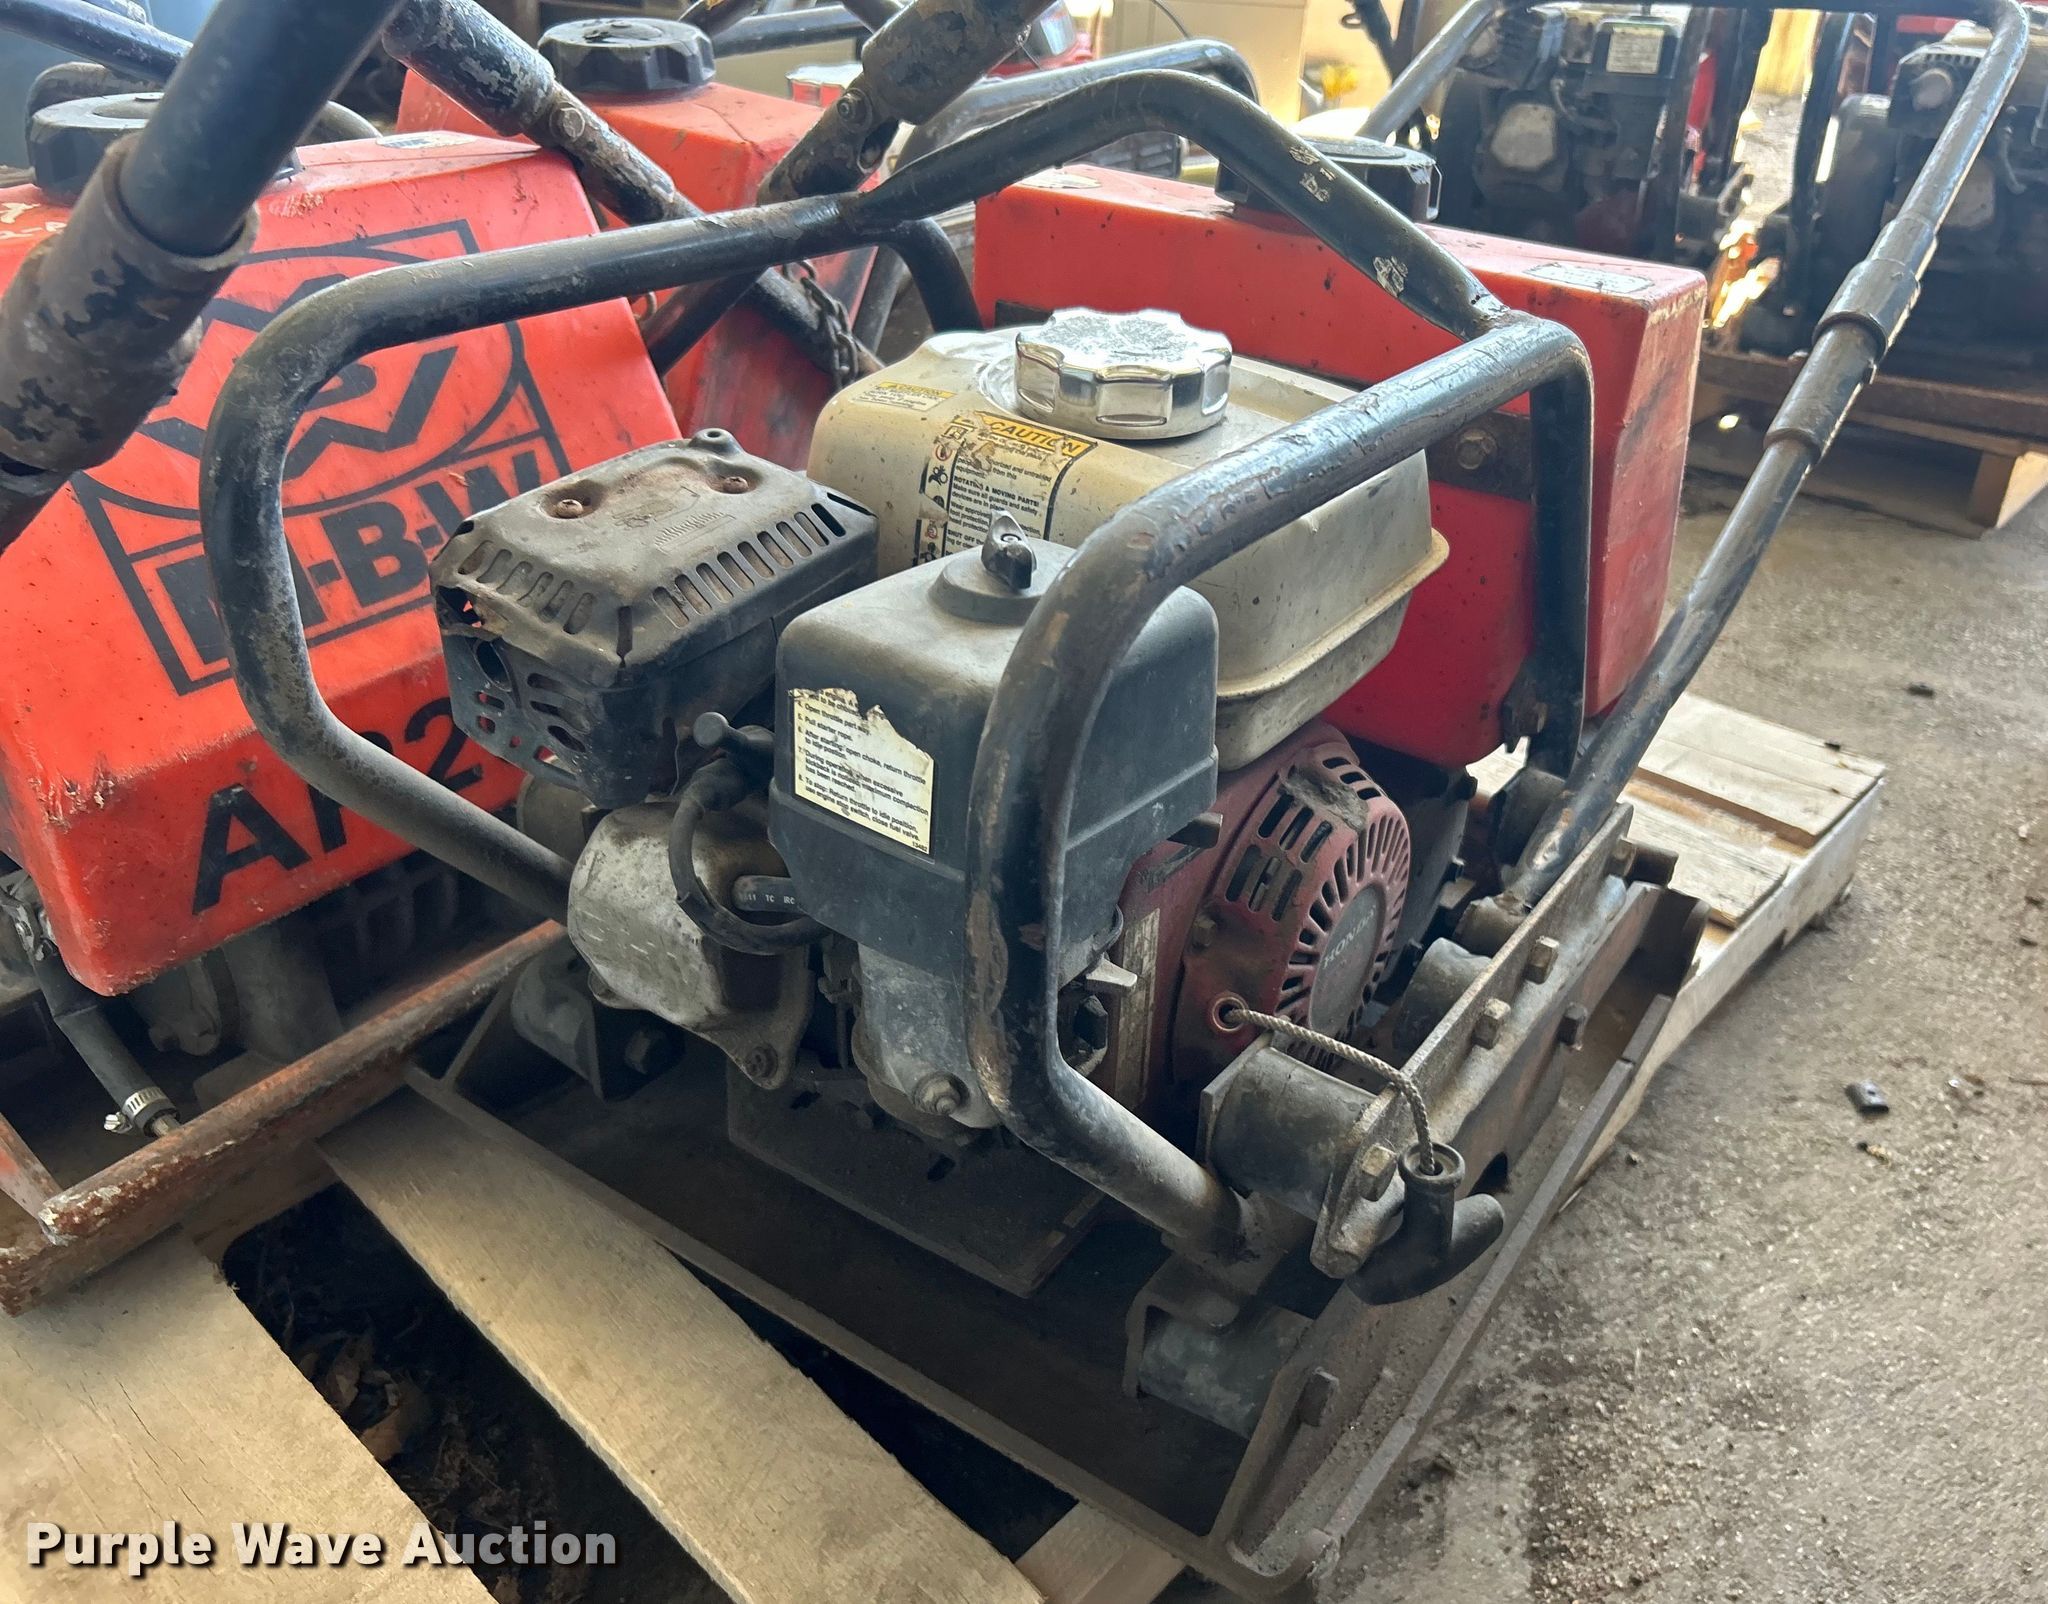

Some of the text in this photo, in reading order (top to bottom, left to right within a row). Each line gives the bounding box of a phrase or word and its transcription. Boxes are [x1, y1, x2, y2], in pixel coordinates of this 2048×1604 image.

[990, 421, 1080, 453] CAUTION
[992, 487, 1016, 500] MOVING
[805, 703, 820, 715] Open
[821, 710, 843, 724] throttle
[805, 716, 816, 726] Pull
[817, 722, 837, 735] starter
[805, 729, 819, 740] After
[845, 747, 861, 759] open
[883, 762, 903, 776] return
[903, 769, 926, 785] throttle
[805, 764, 816, 775] has
[816, 769, 831, 781] been
[804, 749, 825, 765] During
[872, 780, 904, 798] excessive
[805, 756, 830, 773] kickback
[861, 783, 892, 800] maximum
[892, 796, 929, 816] compaction
[805, 785, 816, 795] use
[816, 790, 836, 804] engine
[836, 799, 849, 810] stop
[872, 816, 888, 828] close
[889, 822, 902, 834] fuel
[902, 829, 920, 842] valve.
[829, 787, 849, 803] Return
[849, 797, 871, 812] throttle
[879, 810, 891, 821] idle
[765, 893, 775, 903] TC
